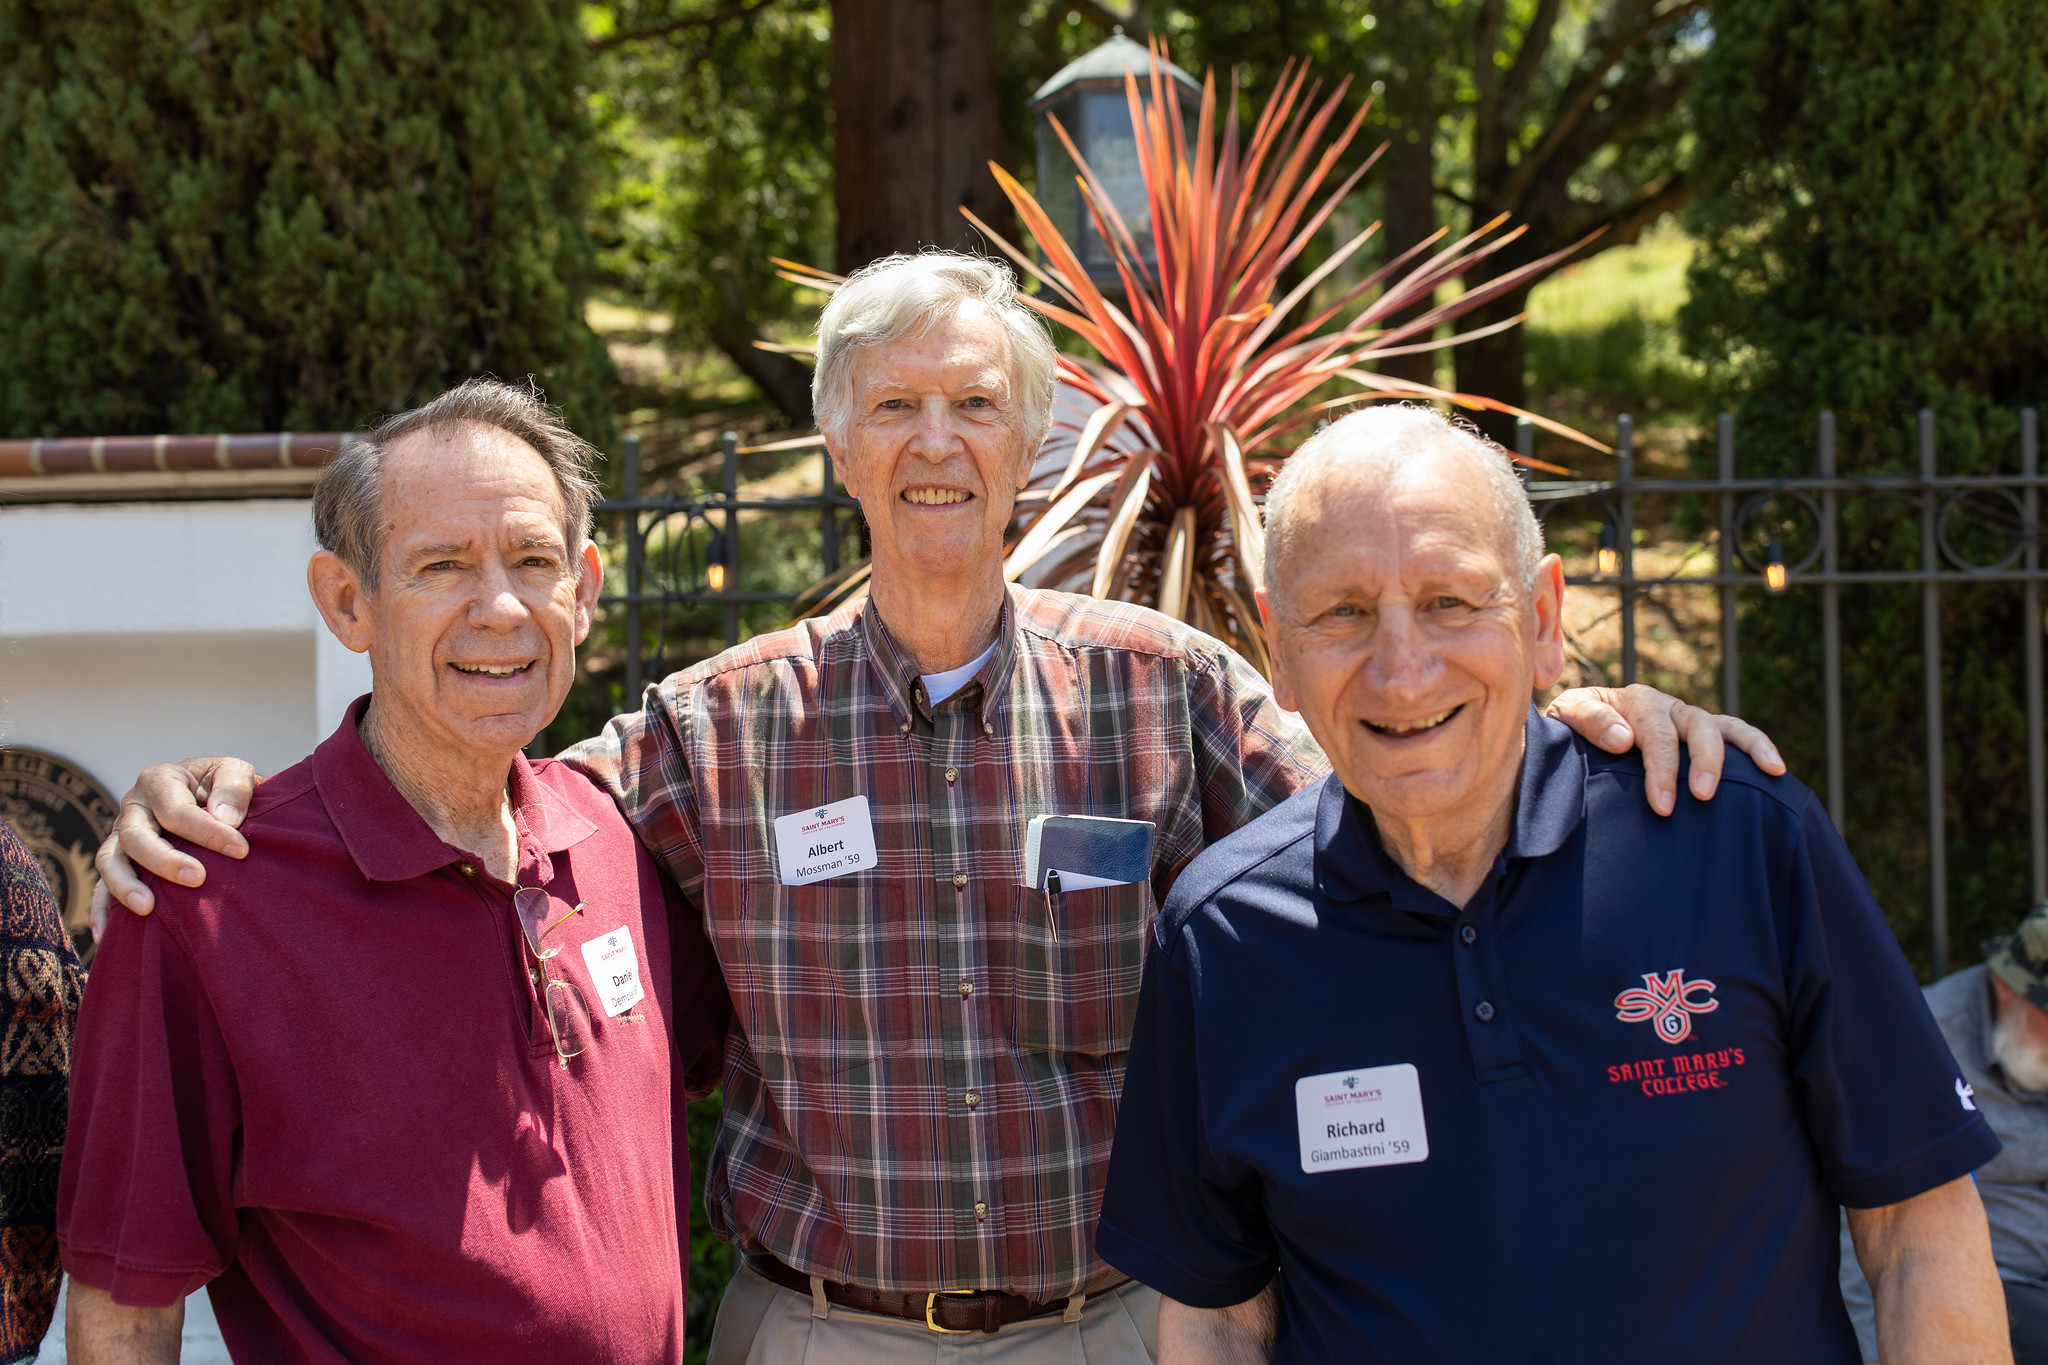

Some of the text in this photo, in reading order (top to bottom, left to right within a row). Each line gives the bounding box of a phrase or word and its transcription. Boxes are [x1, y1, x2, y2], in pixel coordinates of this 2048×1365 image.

[801, 815, 845, 833] SAINT MARY'S
[808, 840, 845, 859] Albert
[796, 853, 860, 878] Mossman '59
[1614, 968, 1719, 1022] SMC
[1607, 1047, 1746, 1083] SAINT MARY'S
[1324, 1088, 1382, 1103] SAINT MARY'S
[1641, 1070, 1720, 1097] COLLEGE
[1326, 1117, 1385, 1139] Richard
[1311, 1139, 1410, 1163] Giambastini '59
